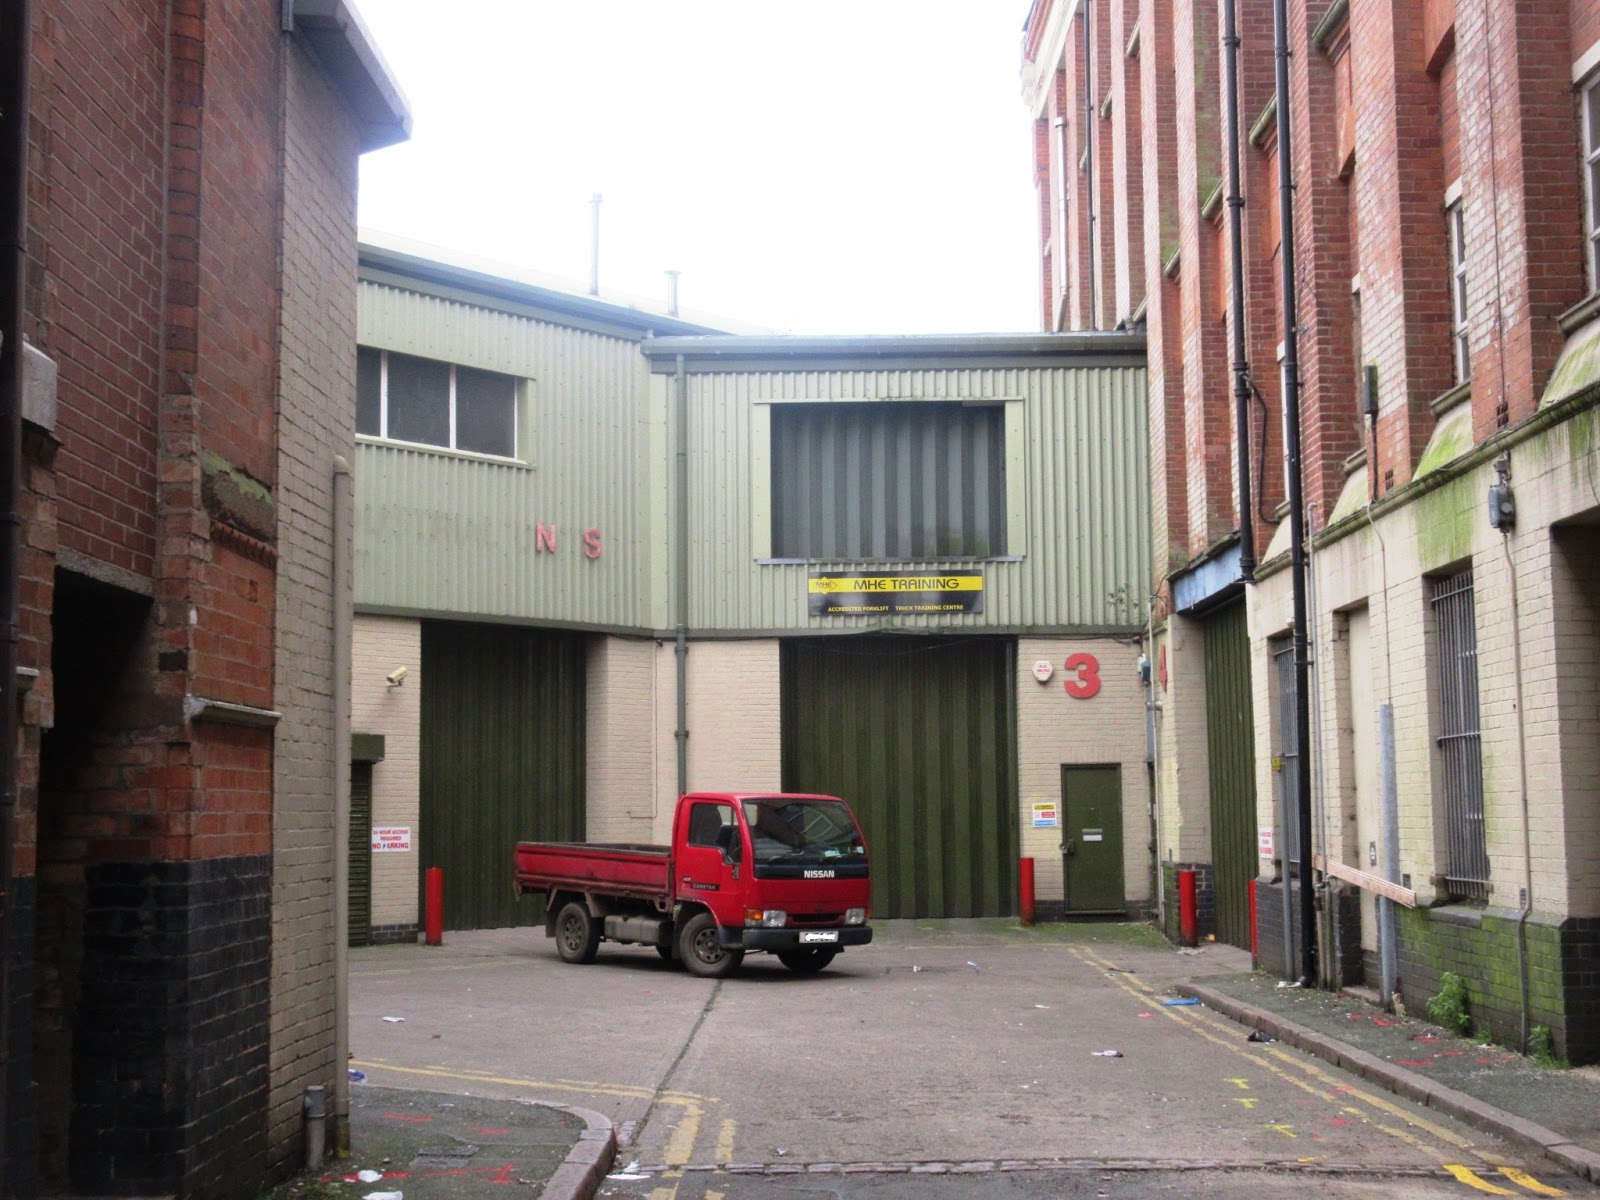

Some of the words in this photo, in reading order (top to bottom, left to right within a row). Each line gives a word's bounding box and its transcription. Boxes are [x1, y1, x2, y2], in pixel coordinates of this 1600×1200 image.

[853, 579, 887, 590] MHE
[891, 578, 960, 590] TRAINING
[1064, 652, 1101, 700] 3
[803, 870, 835, 878] NISSAN
